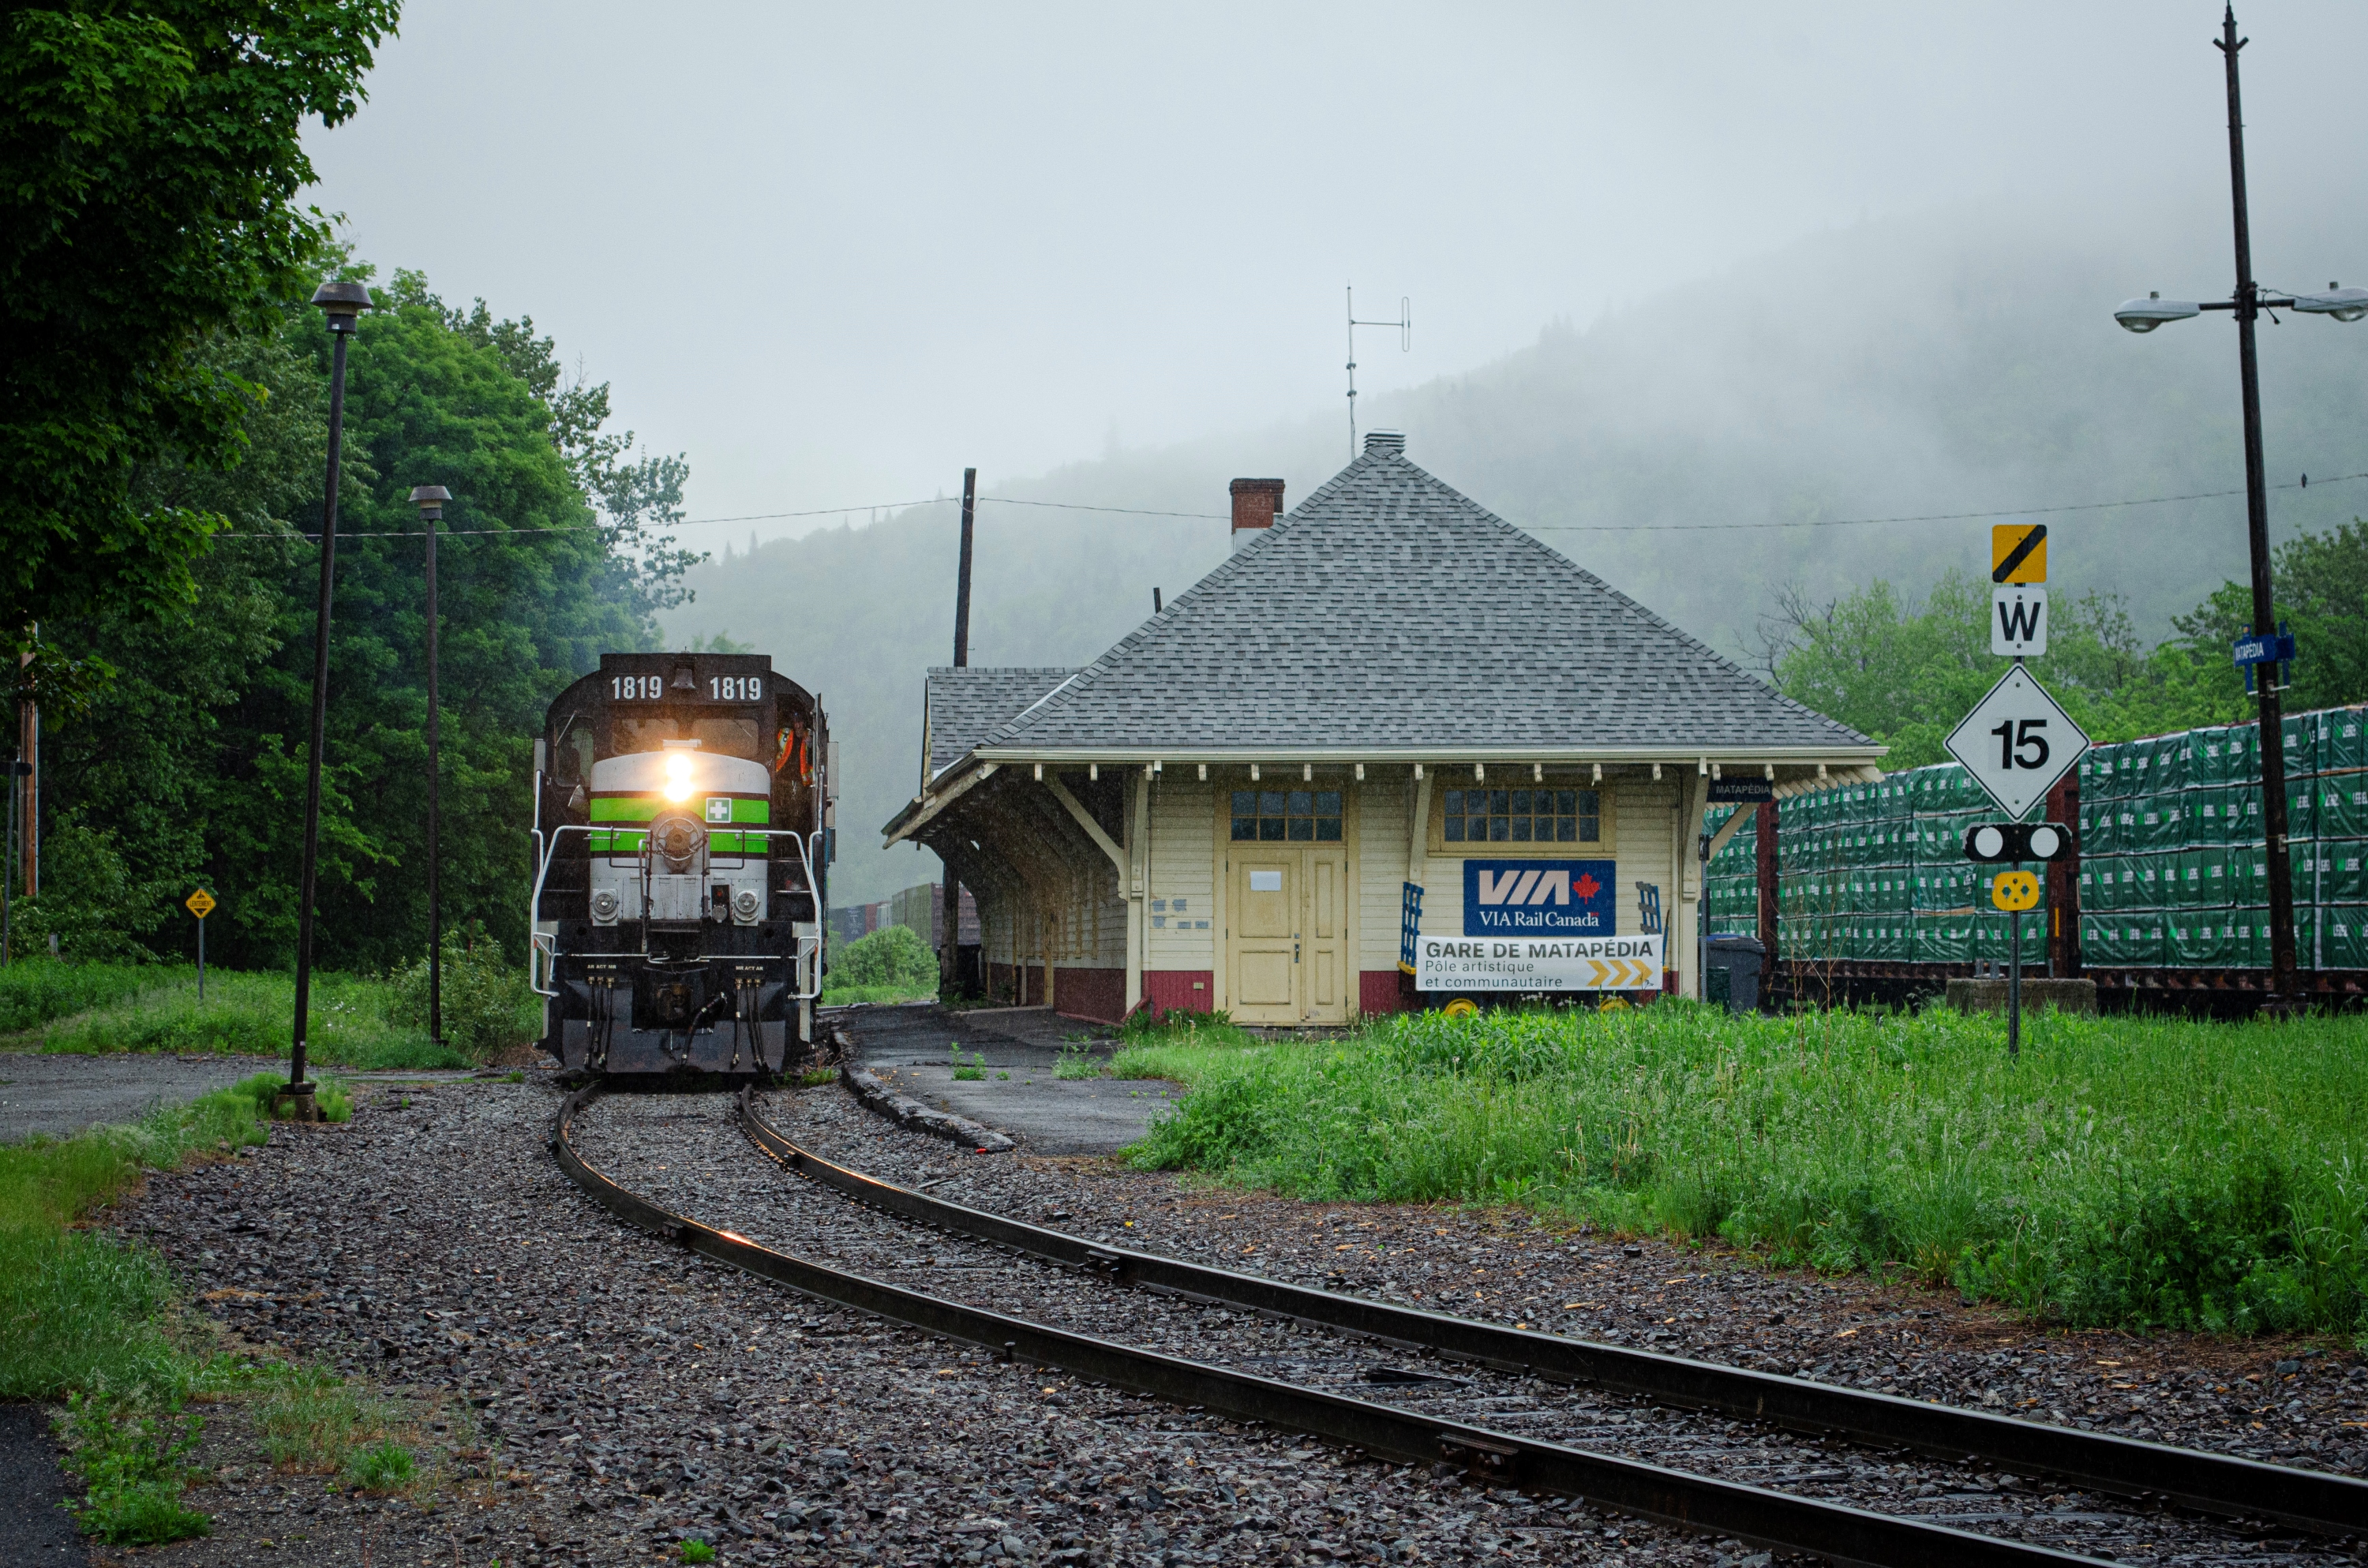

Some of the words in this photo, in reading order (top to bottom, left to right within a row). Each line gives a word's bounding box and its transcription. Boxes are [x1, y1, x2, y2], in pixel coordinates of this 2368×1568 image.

[1998, 601, 2041, 642] W
[612, 676, 662, 700] 1819
[710, 676, 761, 701] 1819
[1991, 719, 2051, 770] 15
[1716, 783, 1770, 794] MATAPÉDIA
[1478, 870, 1570, 905] VIA
[1479, 911, 1512, 926] VIA
[1515, 911, 1543, 926] Rail
[1546, 911, 1600, 926] Canada
[1426, 941, 1485, 959] GARE
[1493, 942, 1519, 958] DE
[1528, 939, 1653, 959] MATAPÉDIA
[1426, 960, 1456, 972] Pôle
[1462, 960, 1534, 973] artistique
[1426, 977, 1441, 988] et
[1445, 976, 1563, 988] communautaire
